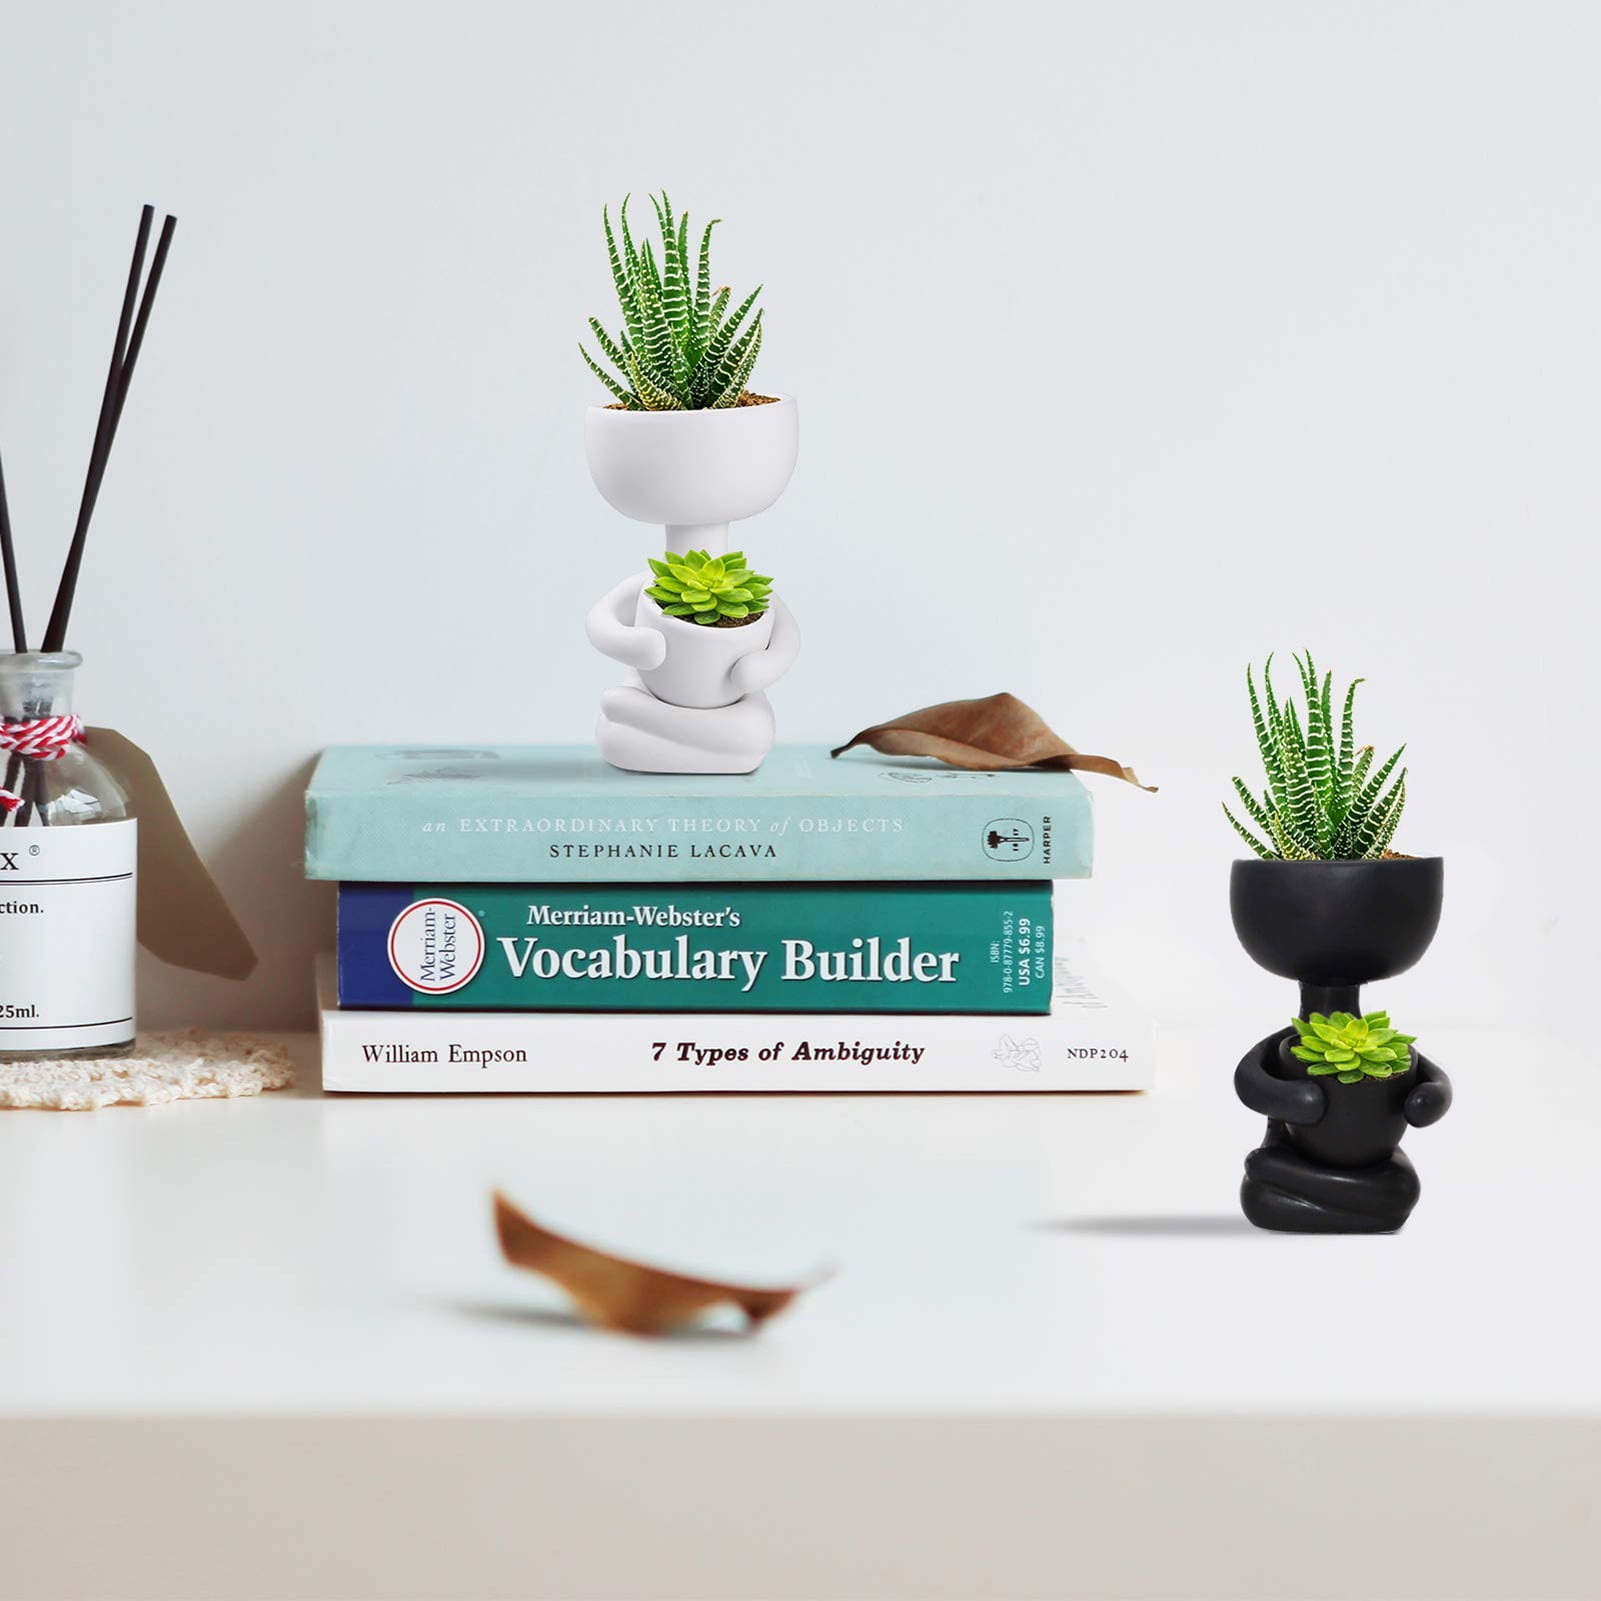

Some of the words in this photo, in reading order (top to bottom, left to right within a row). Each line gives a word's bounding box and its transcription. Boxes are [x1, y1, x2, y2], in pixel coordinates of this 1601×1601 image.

[422, 822, 446, 833] an
[460, 818, 658, 833] EXTRAORDINARY
[667, 818, 762, 833] THEORY
[770, 815, 791, 836] of
[799, 818, 904, 834] OBJECTS
[549, 844, 679, 859] STEPHANIE
[690, 844, 778, 858] LACAVA
[1042, 816, 1052, 865] HARPER
[526, 904, 741, 928] Merriam-Webster's
[419, 906, 436, 982] Merriam-
[438, 913, 457, 981] Webster
[1018, 918, 1031, 955] $6.99
[1034, 925, 1046, 954] $8.99
[496, 934, 769, 992] Vocabulary
[780, 936, 960, 983] Builder
[1018, 957, 1031, 986] USA
[1034, 956, 1045, 979] CAN
[361, 1044, 439, 1064] William
[447, 1043, 528, 1069] Empson
[651, 1041, 668, 1062] 7
[676, 1041, 750, 1067] Types
[757, 1040, 784, 1063] of
[791, 1041, 926, 1066] Ambiguity
[1066, 1047, 1129, 1063] NDP204
